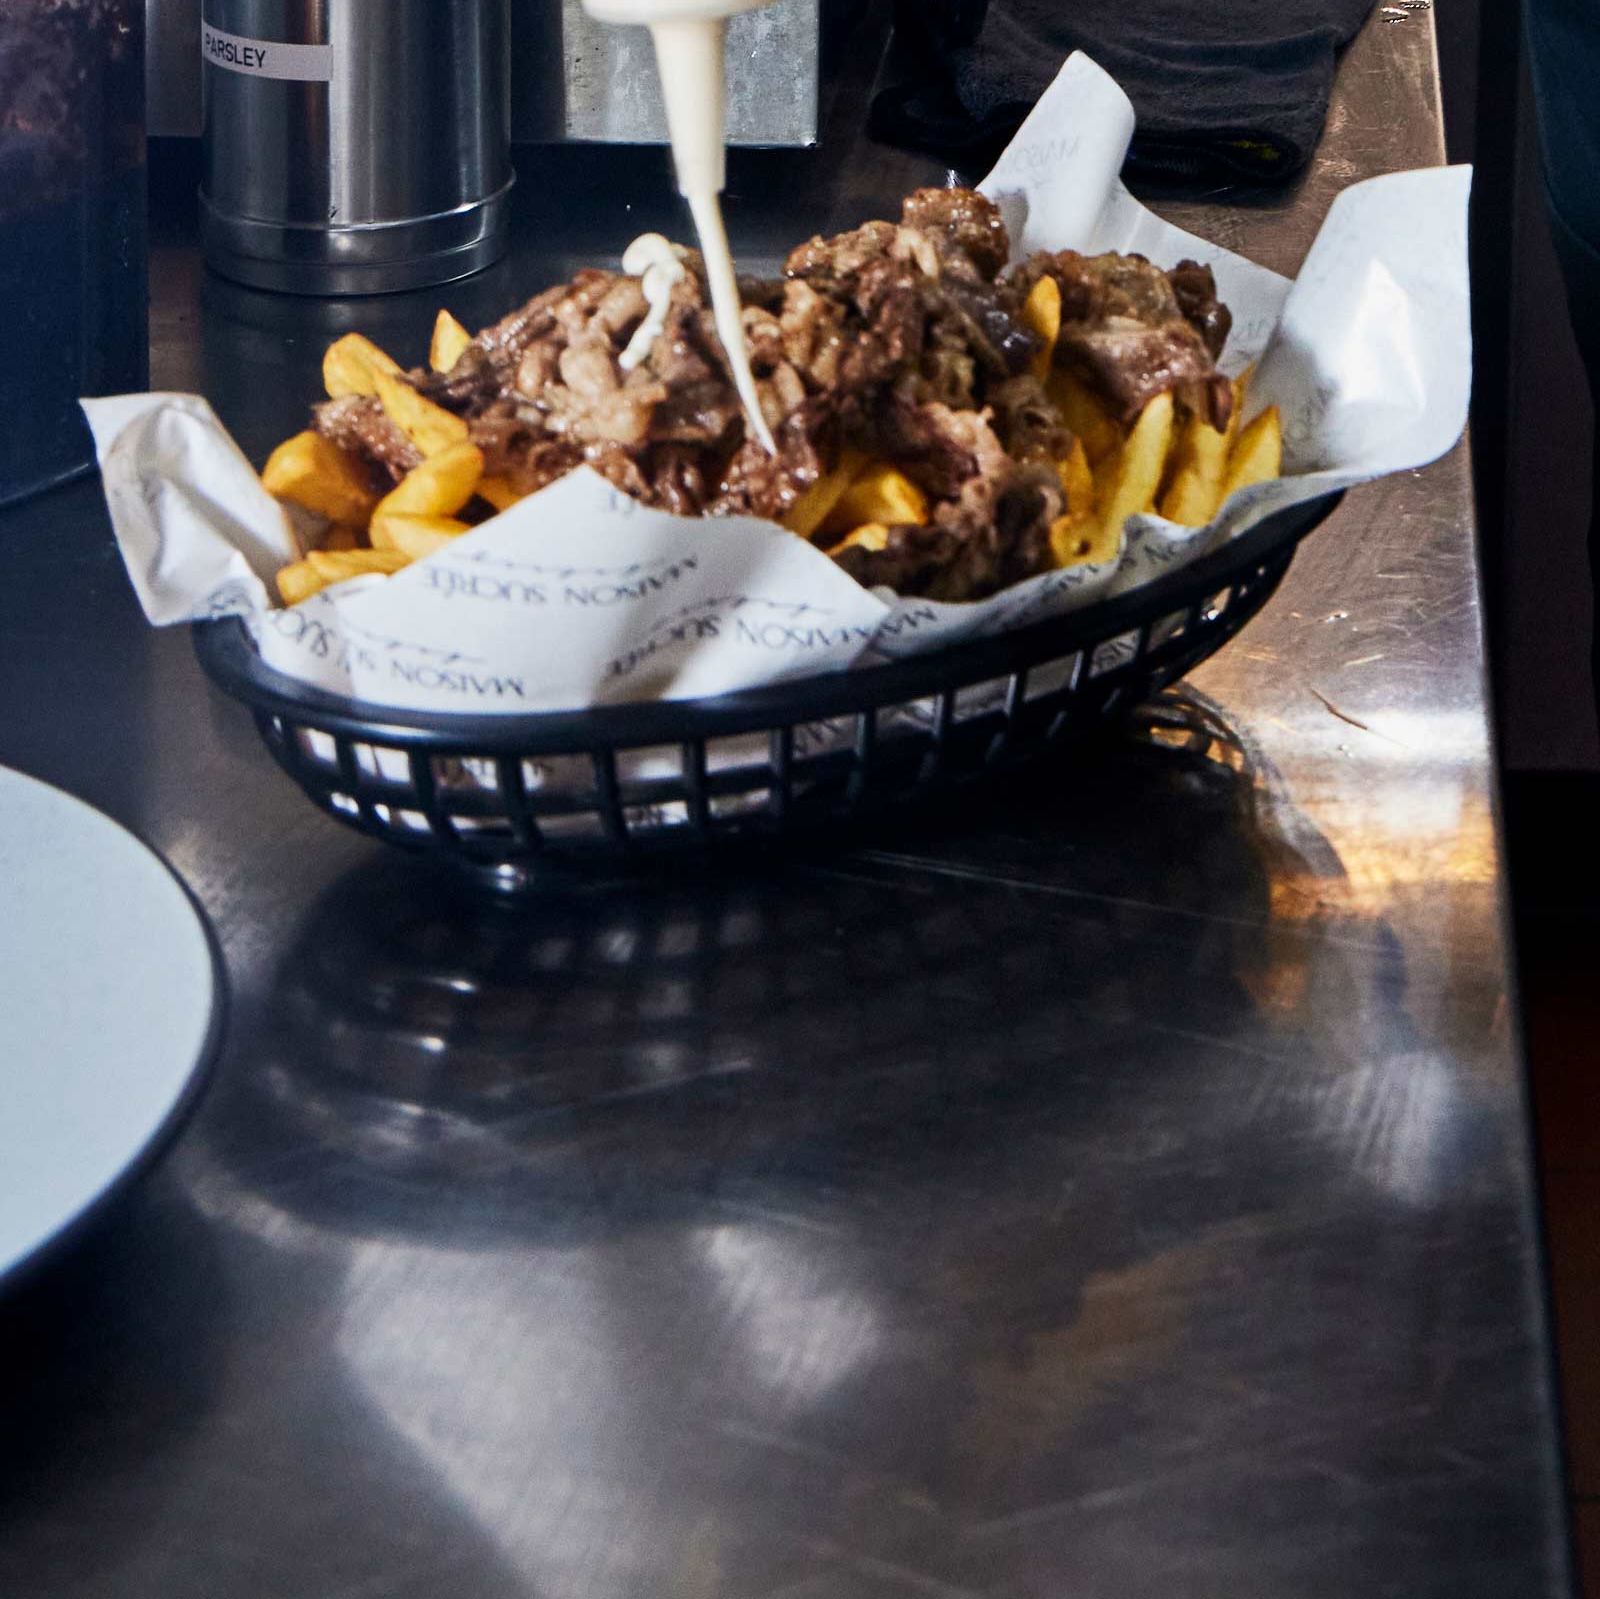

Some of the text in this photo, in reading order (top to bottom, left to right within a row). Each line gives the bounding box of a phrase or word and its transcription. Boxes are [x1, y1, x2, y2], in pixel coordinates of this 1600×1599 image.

[204, 32, 266, 68] PARSLEY
[564, 555, 699, 606] MAISON
[390, 657, 527, 698] MAISON
